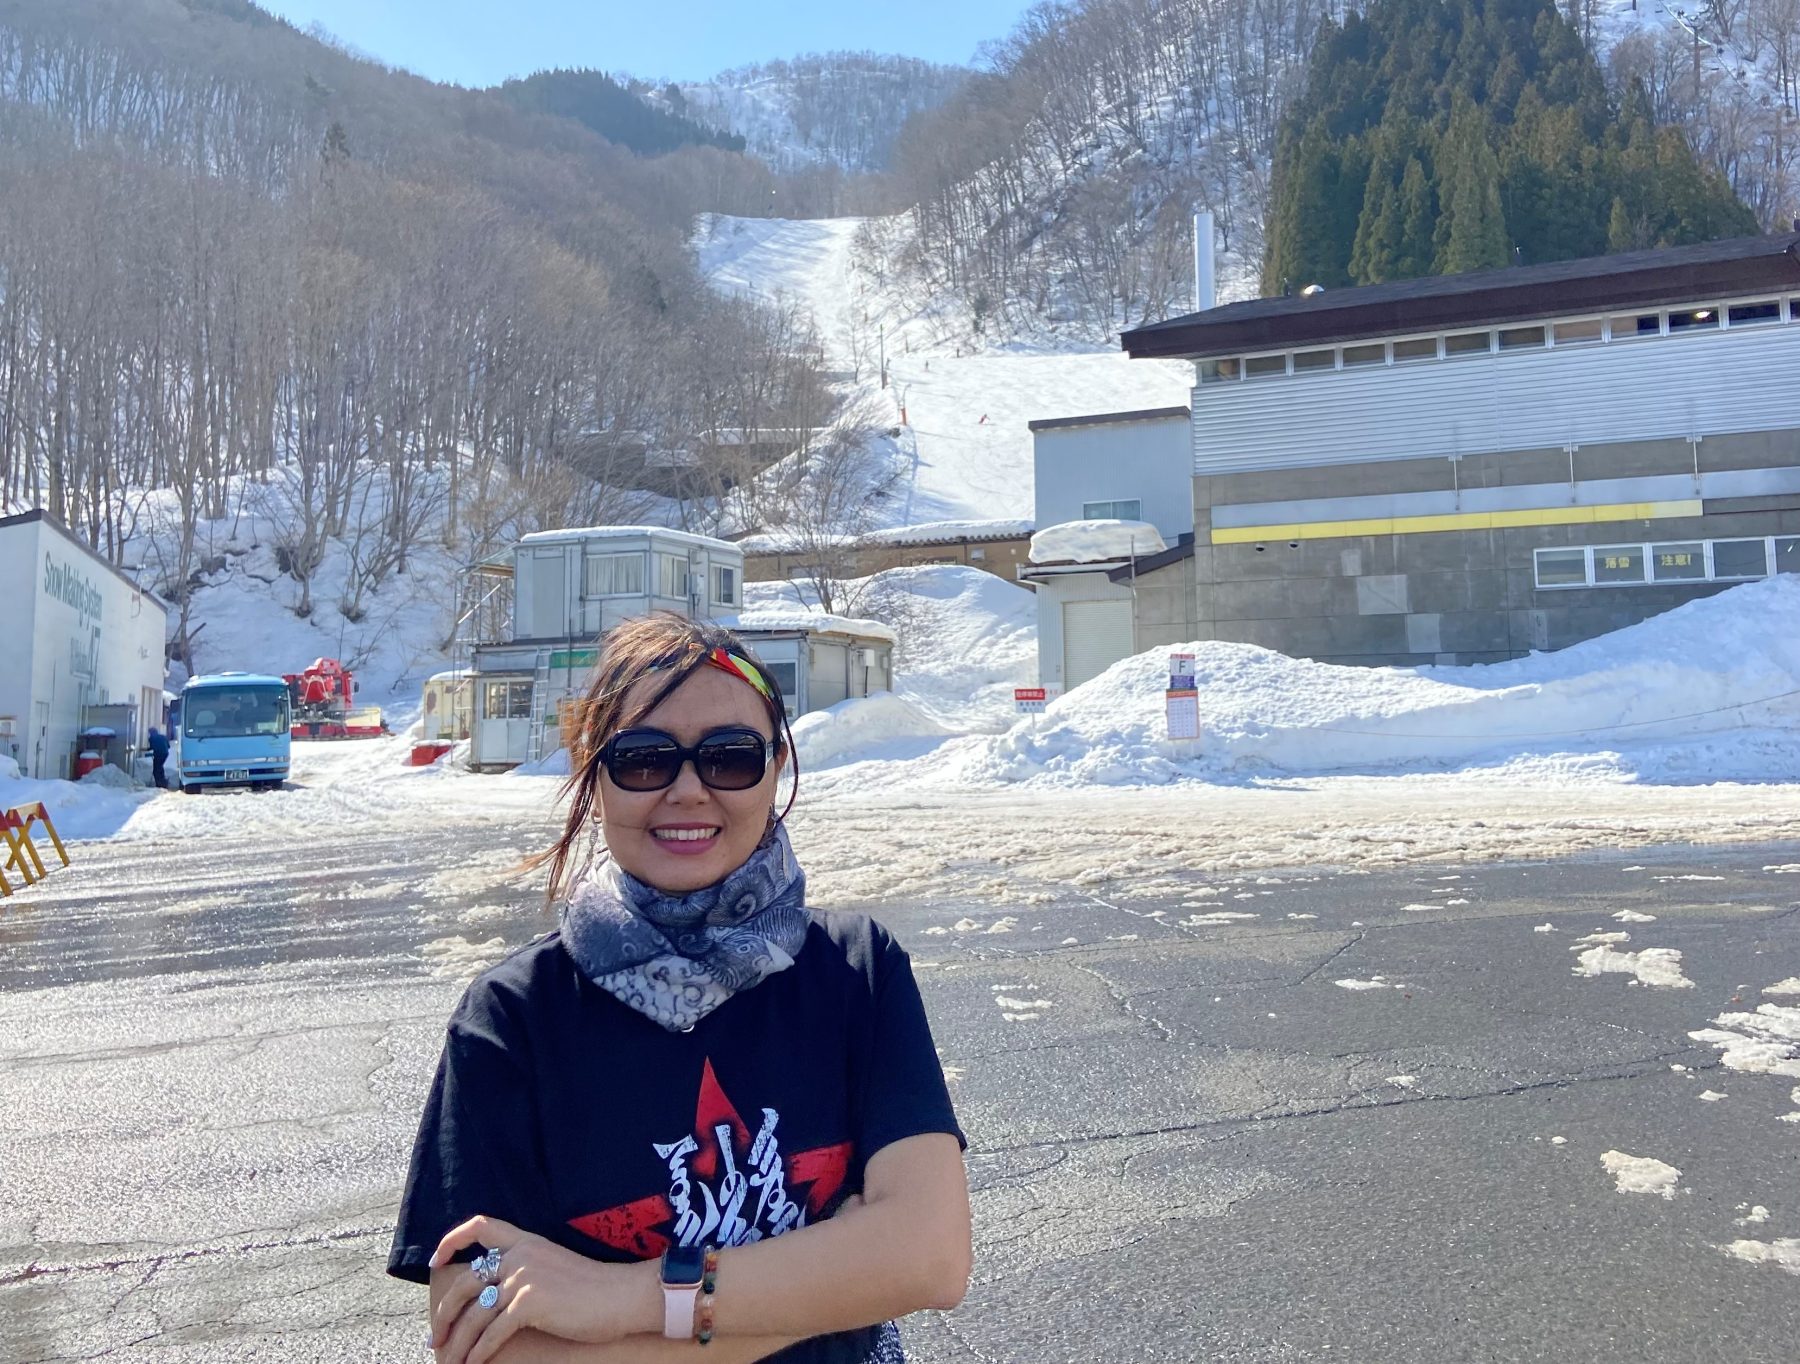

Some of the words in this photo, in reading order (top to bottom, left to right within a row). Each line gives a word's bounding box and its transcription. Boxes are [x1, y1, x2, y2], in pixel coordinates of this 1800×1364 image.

[1605, 557, 1630, 569] 落雪
[44, 550, 63, 602] Snow
[62, 562, 84, 628] Making
[84, 576, 102, 631] System
[1178, 660, 1186, 673] F
